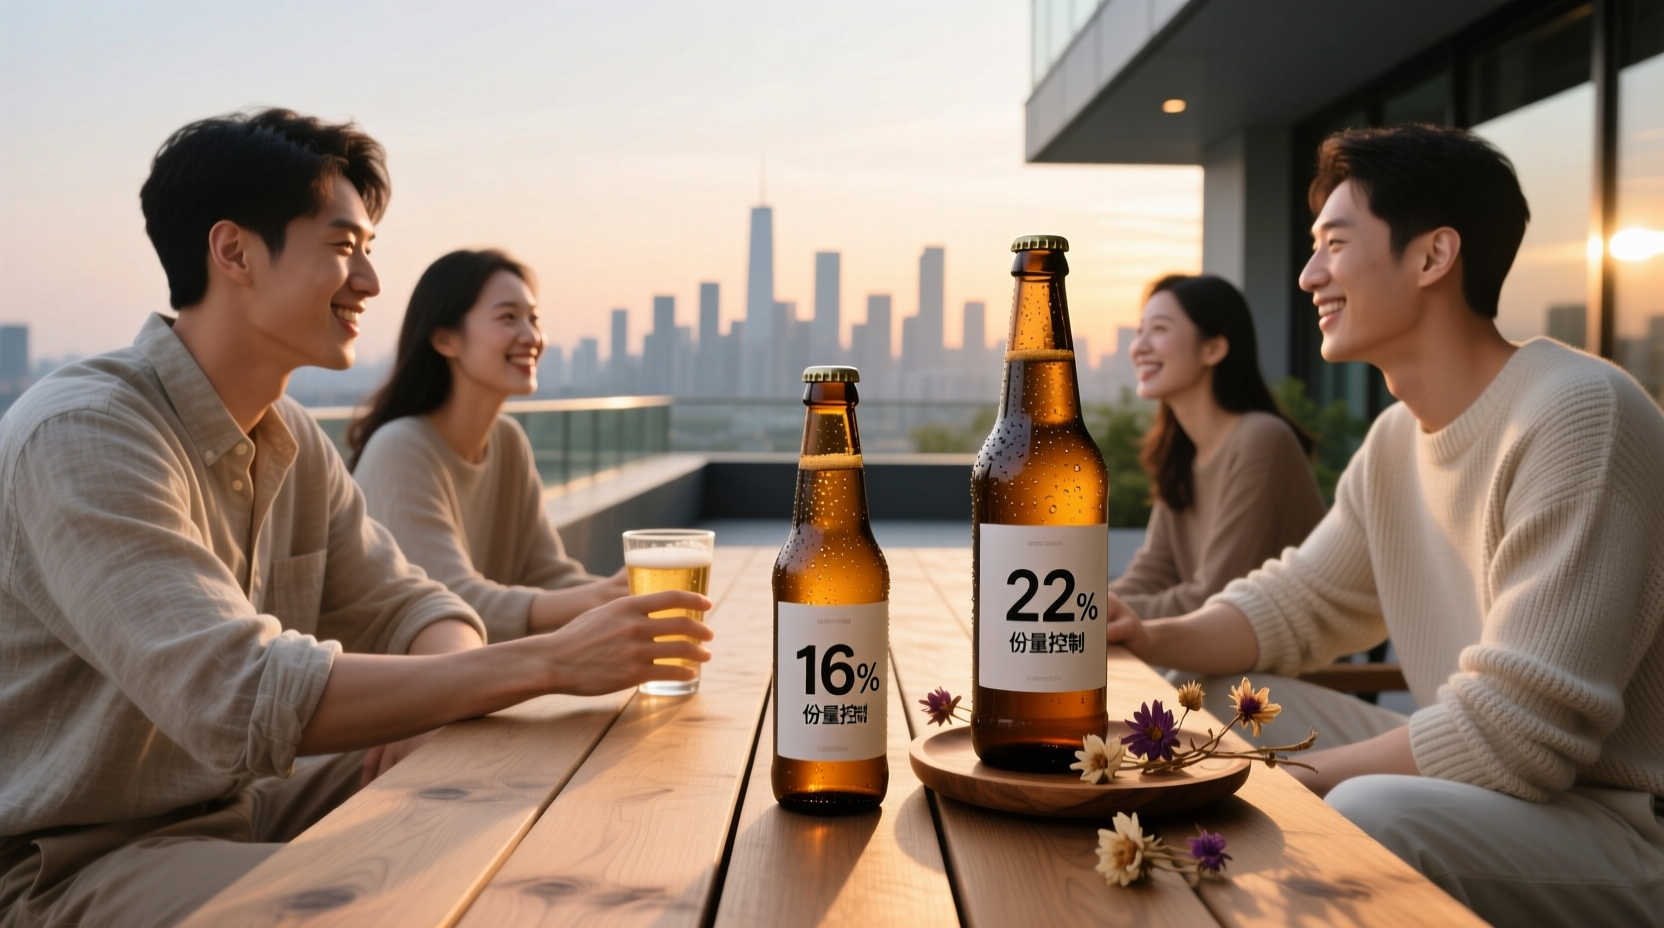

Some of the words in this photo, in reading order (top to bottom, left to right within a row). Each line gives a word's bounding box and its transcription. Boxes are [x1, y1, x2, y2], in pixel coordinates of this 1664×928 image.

[1005, 568, 1099, 623] 22%
[796, 643, 880, 696] 16%
[1009, 631, 1085, 655] 份量控制
